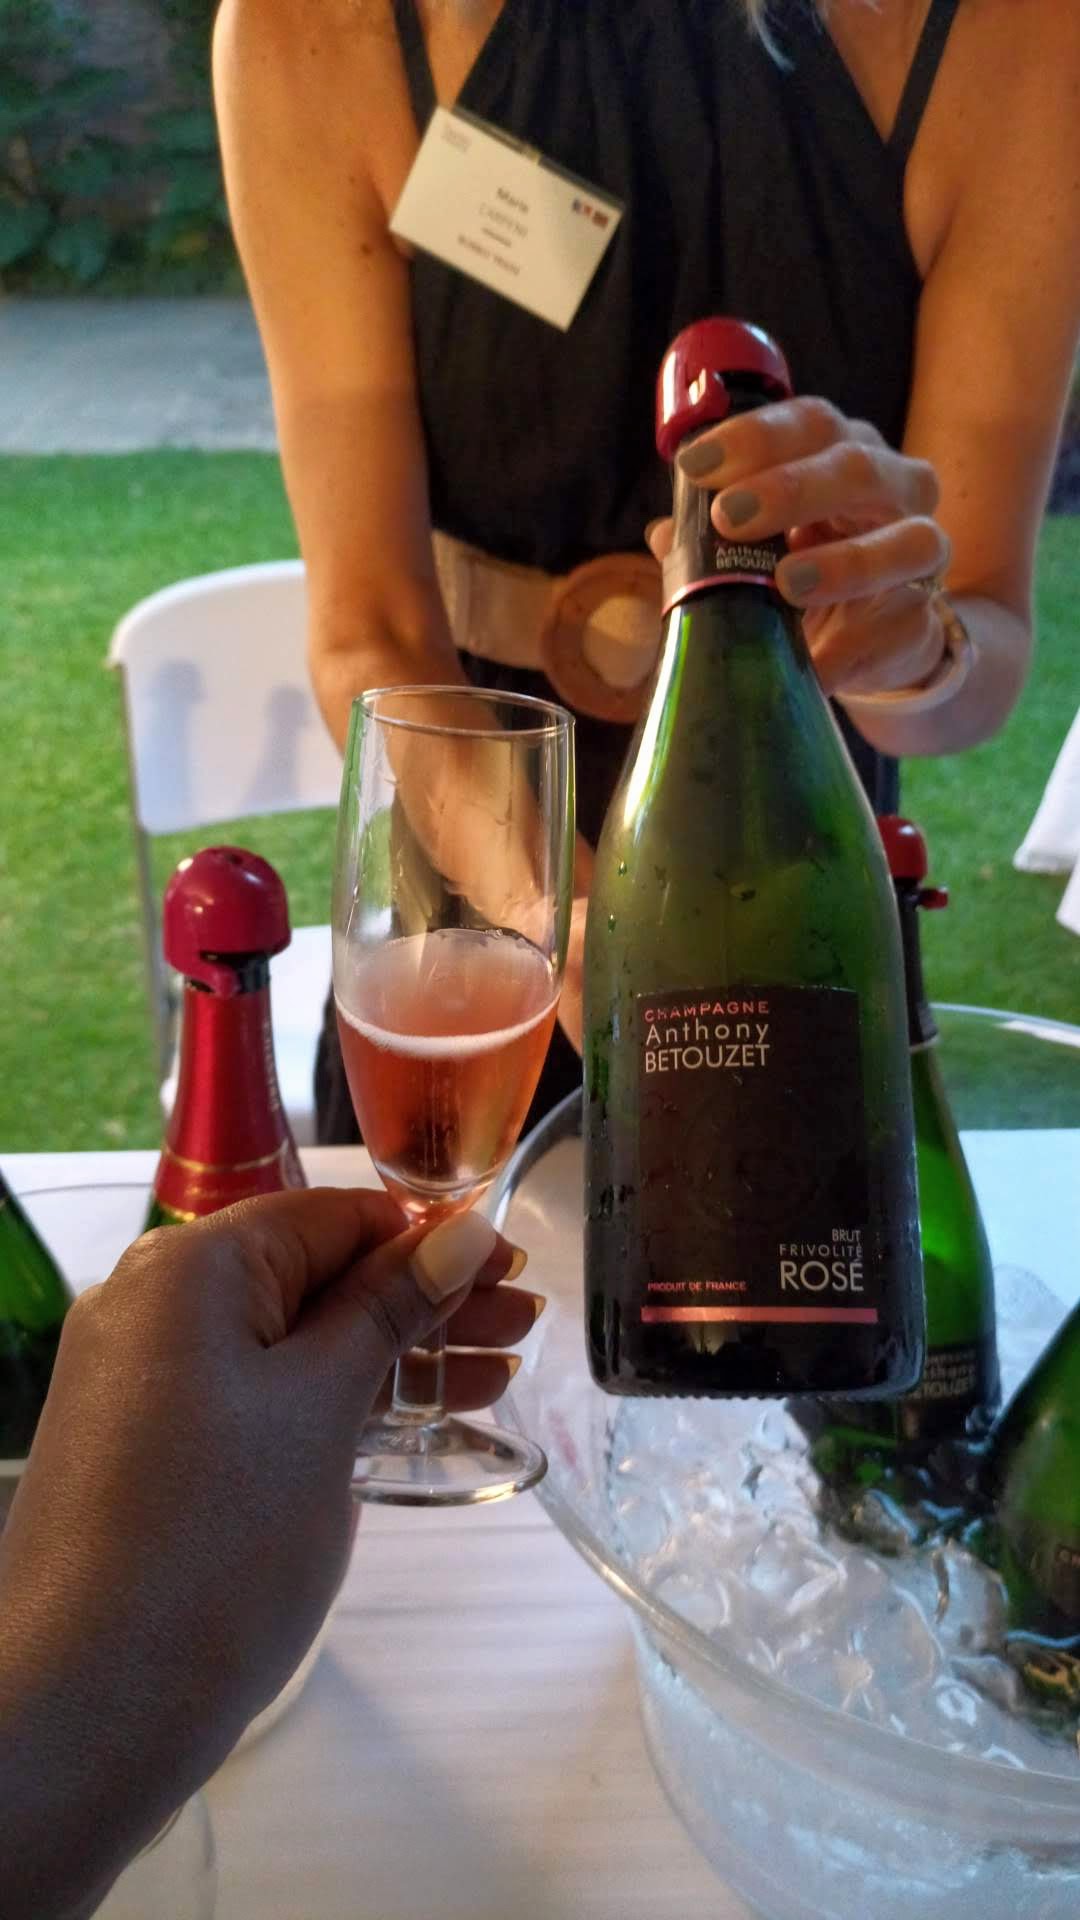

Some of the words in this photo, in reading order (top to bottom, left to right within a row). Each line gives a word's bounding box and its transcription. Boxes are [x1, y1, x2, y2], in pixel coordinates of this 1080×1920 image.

[716, 557, 775, 571] BETOUZE
[644, 1001, 769, 1022] CHAMPAGNE
[645, 1018, 769, 1045] Anthony
[645, 1044, 770, 1073] BETOUZET
[832, 1228, 861, 1242] BRUT
[779, 1243, 863, 1258] FRIVOLITÉ
[780, 1259, 864, 1292] ROSÉ
[647, 1281, 685, 1292] PRODUIT
[688, 1281, 701, 1292] DE
[705, 1280, 747, 1291] FRANCE
